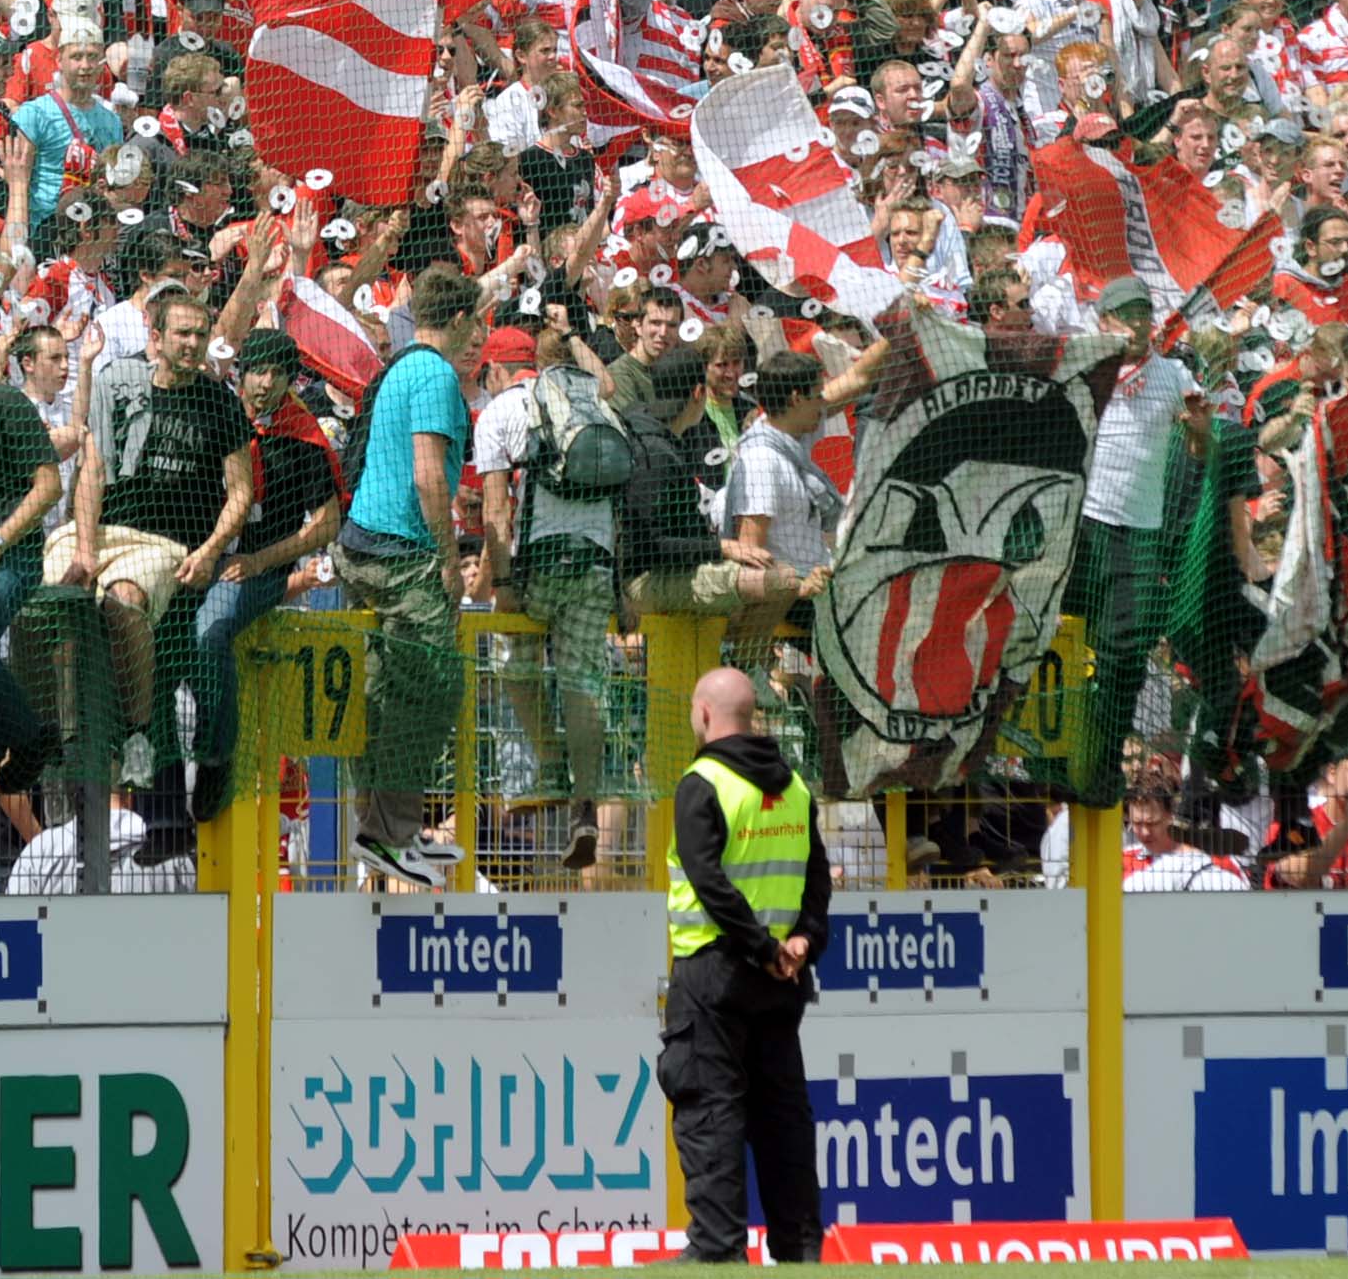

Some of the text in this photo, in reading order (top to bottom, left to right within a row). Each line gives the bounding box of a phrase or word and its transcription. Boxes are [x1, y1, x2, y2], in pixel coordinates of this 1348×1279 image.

[294, 645, 352, 741] 19
[409, 927, 532, 972] Imtech
[846, 925, 955, 970] Imtech
[288, 1055, 652, 1194] SCHOLZ
[815, 1096, 1015, 1188] mtech
